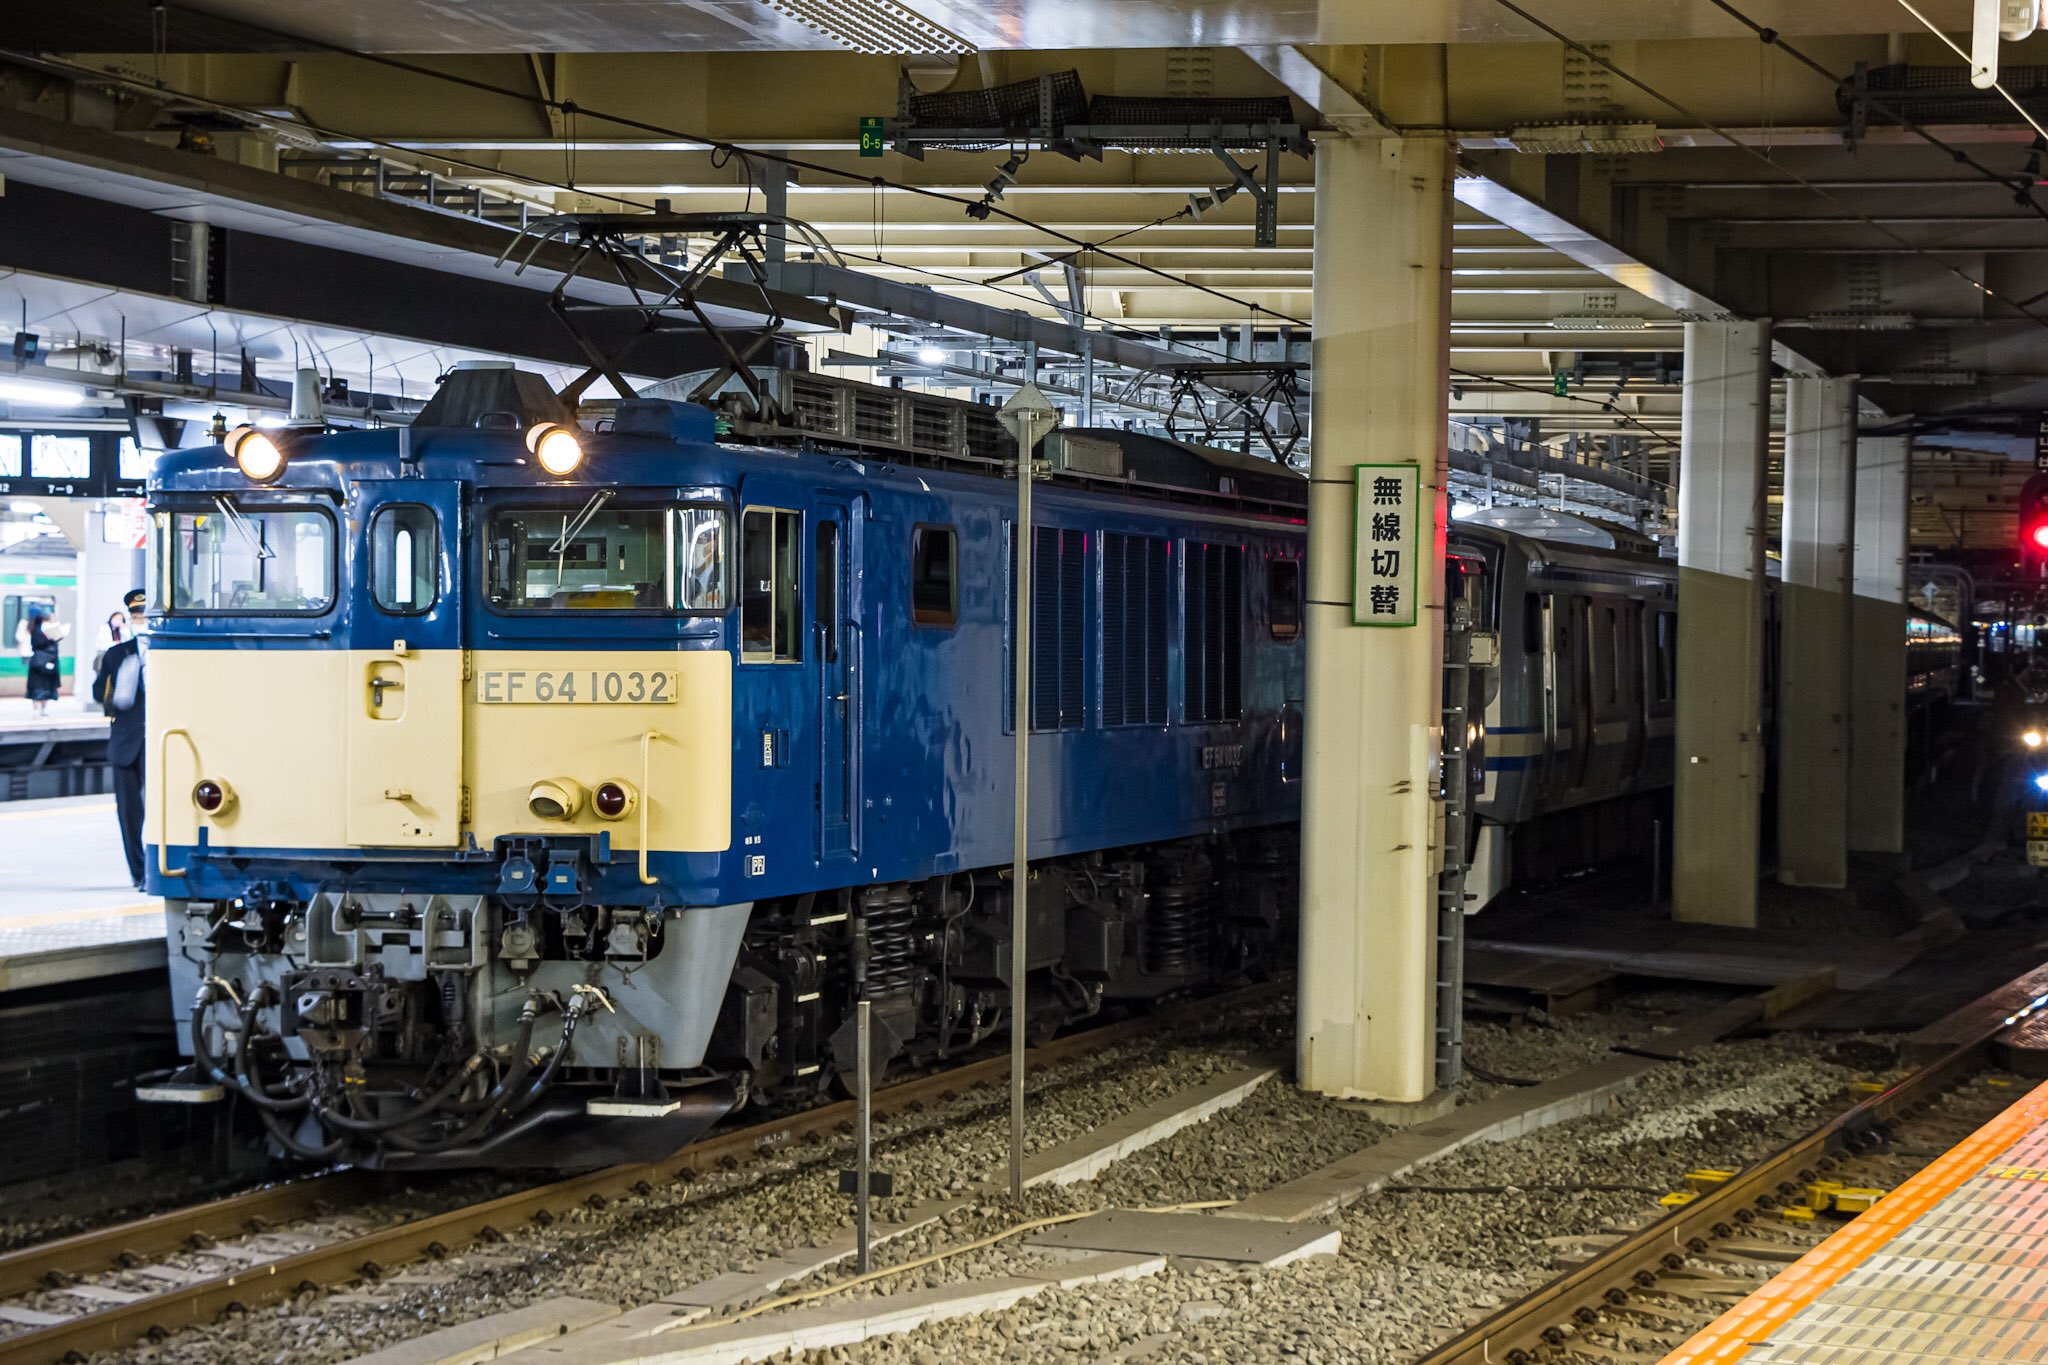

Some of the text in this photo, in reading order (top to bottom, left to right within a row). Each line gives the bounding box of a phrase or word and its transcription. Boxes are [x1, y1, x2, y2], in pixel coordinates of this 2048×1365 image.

[863, 133, 880, 149] 6-5
[1370, 476, 1402, 615] 無線切替
[591, 672, 669, 702] 1032
